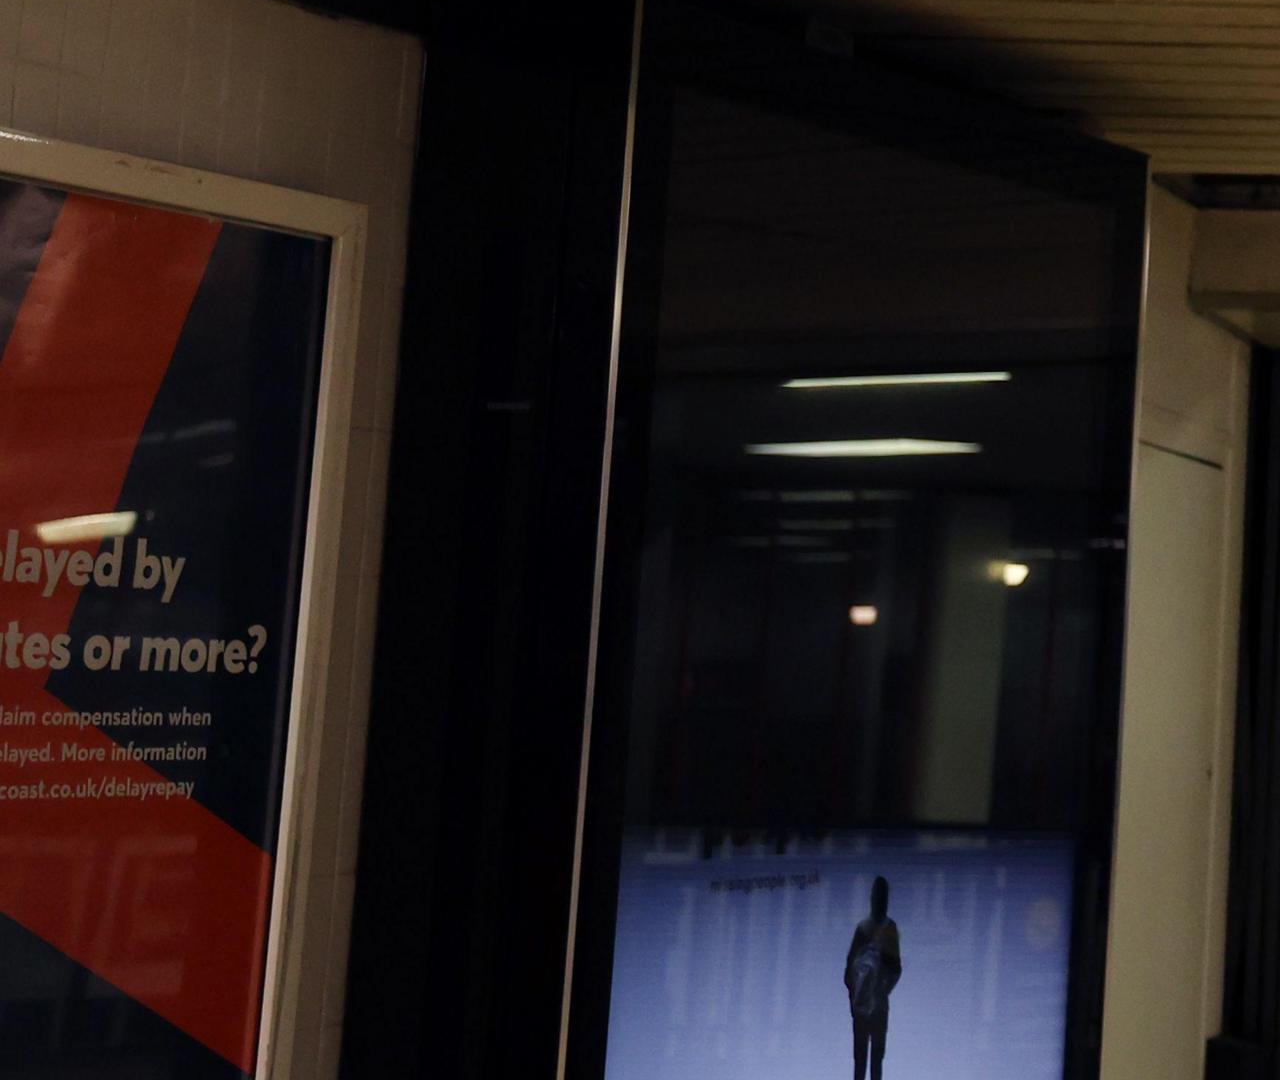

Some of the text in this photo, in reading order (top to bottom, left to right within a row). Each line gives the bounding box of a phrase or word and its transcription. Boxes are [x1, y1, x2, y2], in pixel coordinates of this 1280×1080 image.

[0, 528, 186, 603] layed by
[0, 620, 268, 674] tes or more?
[41, 706, 164, 729] compensation
[168, 705, 212, 726] when
[61, 742, 105, 762] More
[111, 740, 207, 762] information
